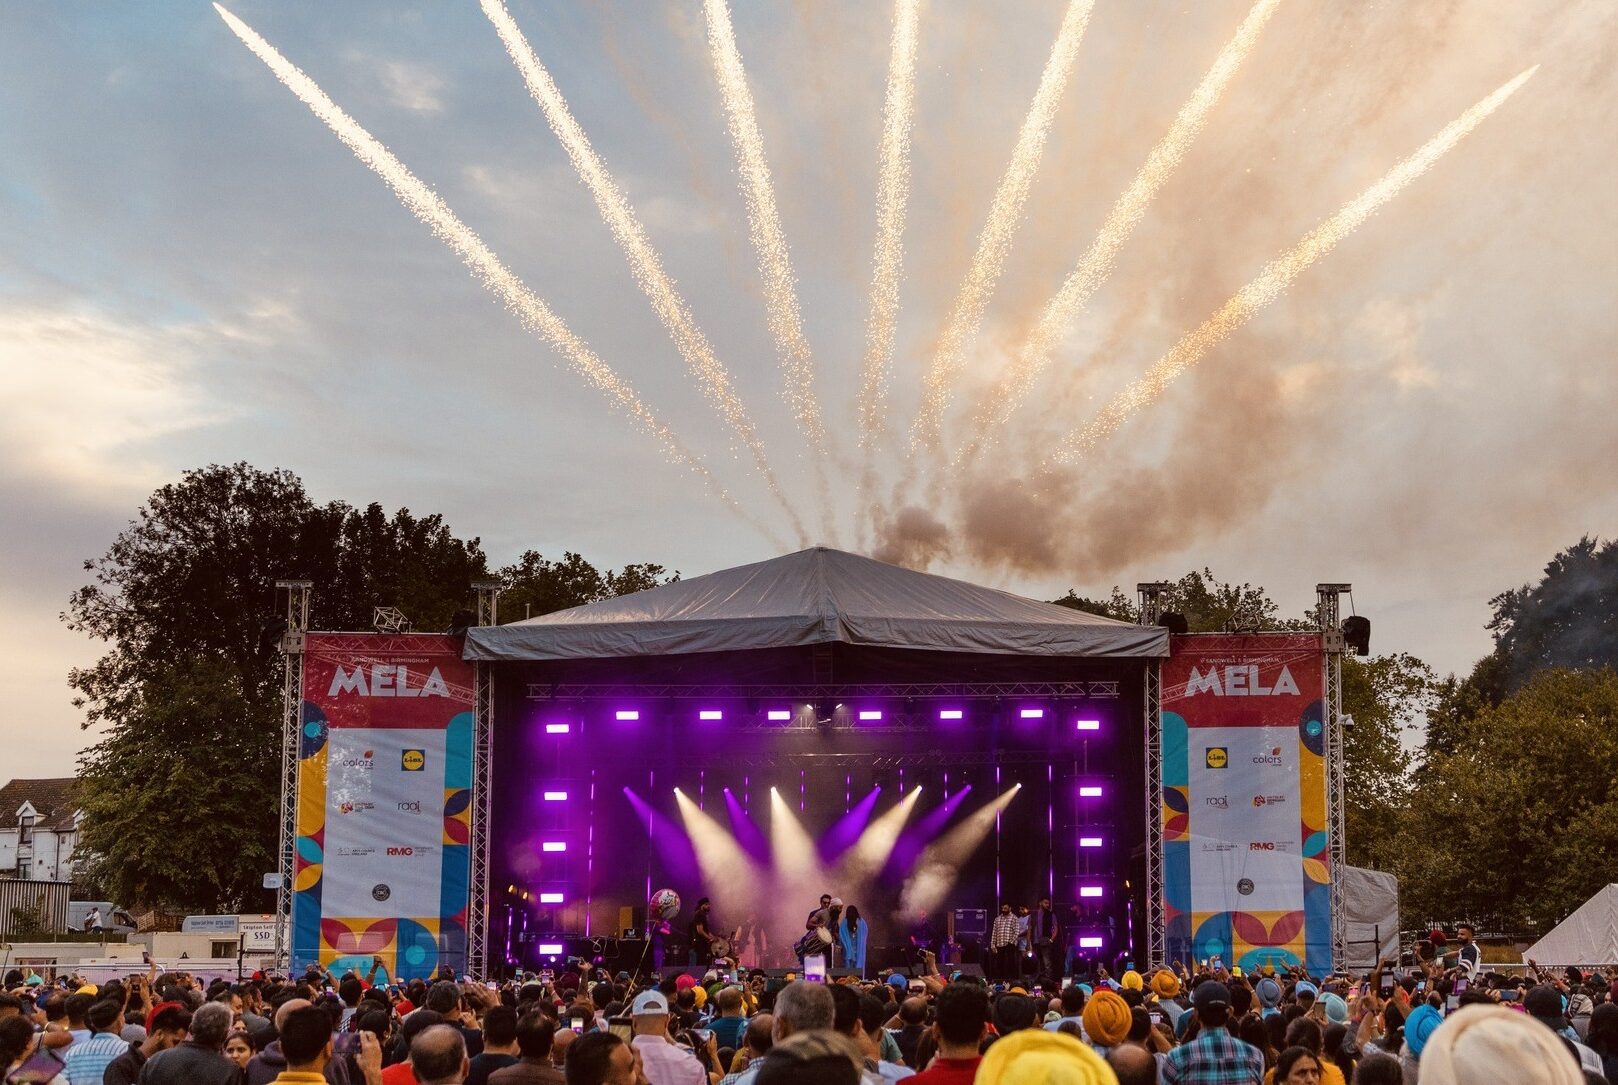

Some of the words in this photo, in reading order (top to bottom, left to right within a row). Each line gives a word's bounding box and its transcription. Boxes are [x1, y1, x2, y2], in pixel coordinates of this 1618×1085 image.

[328, 664, 450, 697] MELA
[1185, 664, 1301, 696] MELA
[342, 758, 374, 767] colors
[1252, 754, 1282, 764] colors
[1249, 842, 1275, 851] RMG
[387, 847, 413, 856] RMG
[254, 931, 270, 939] SSD
